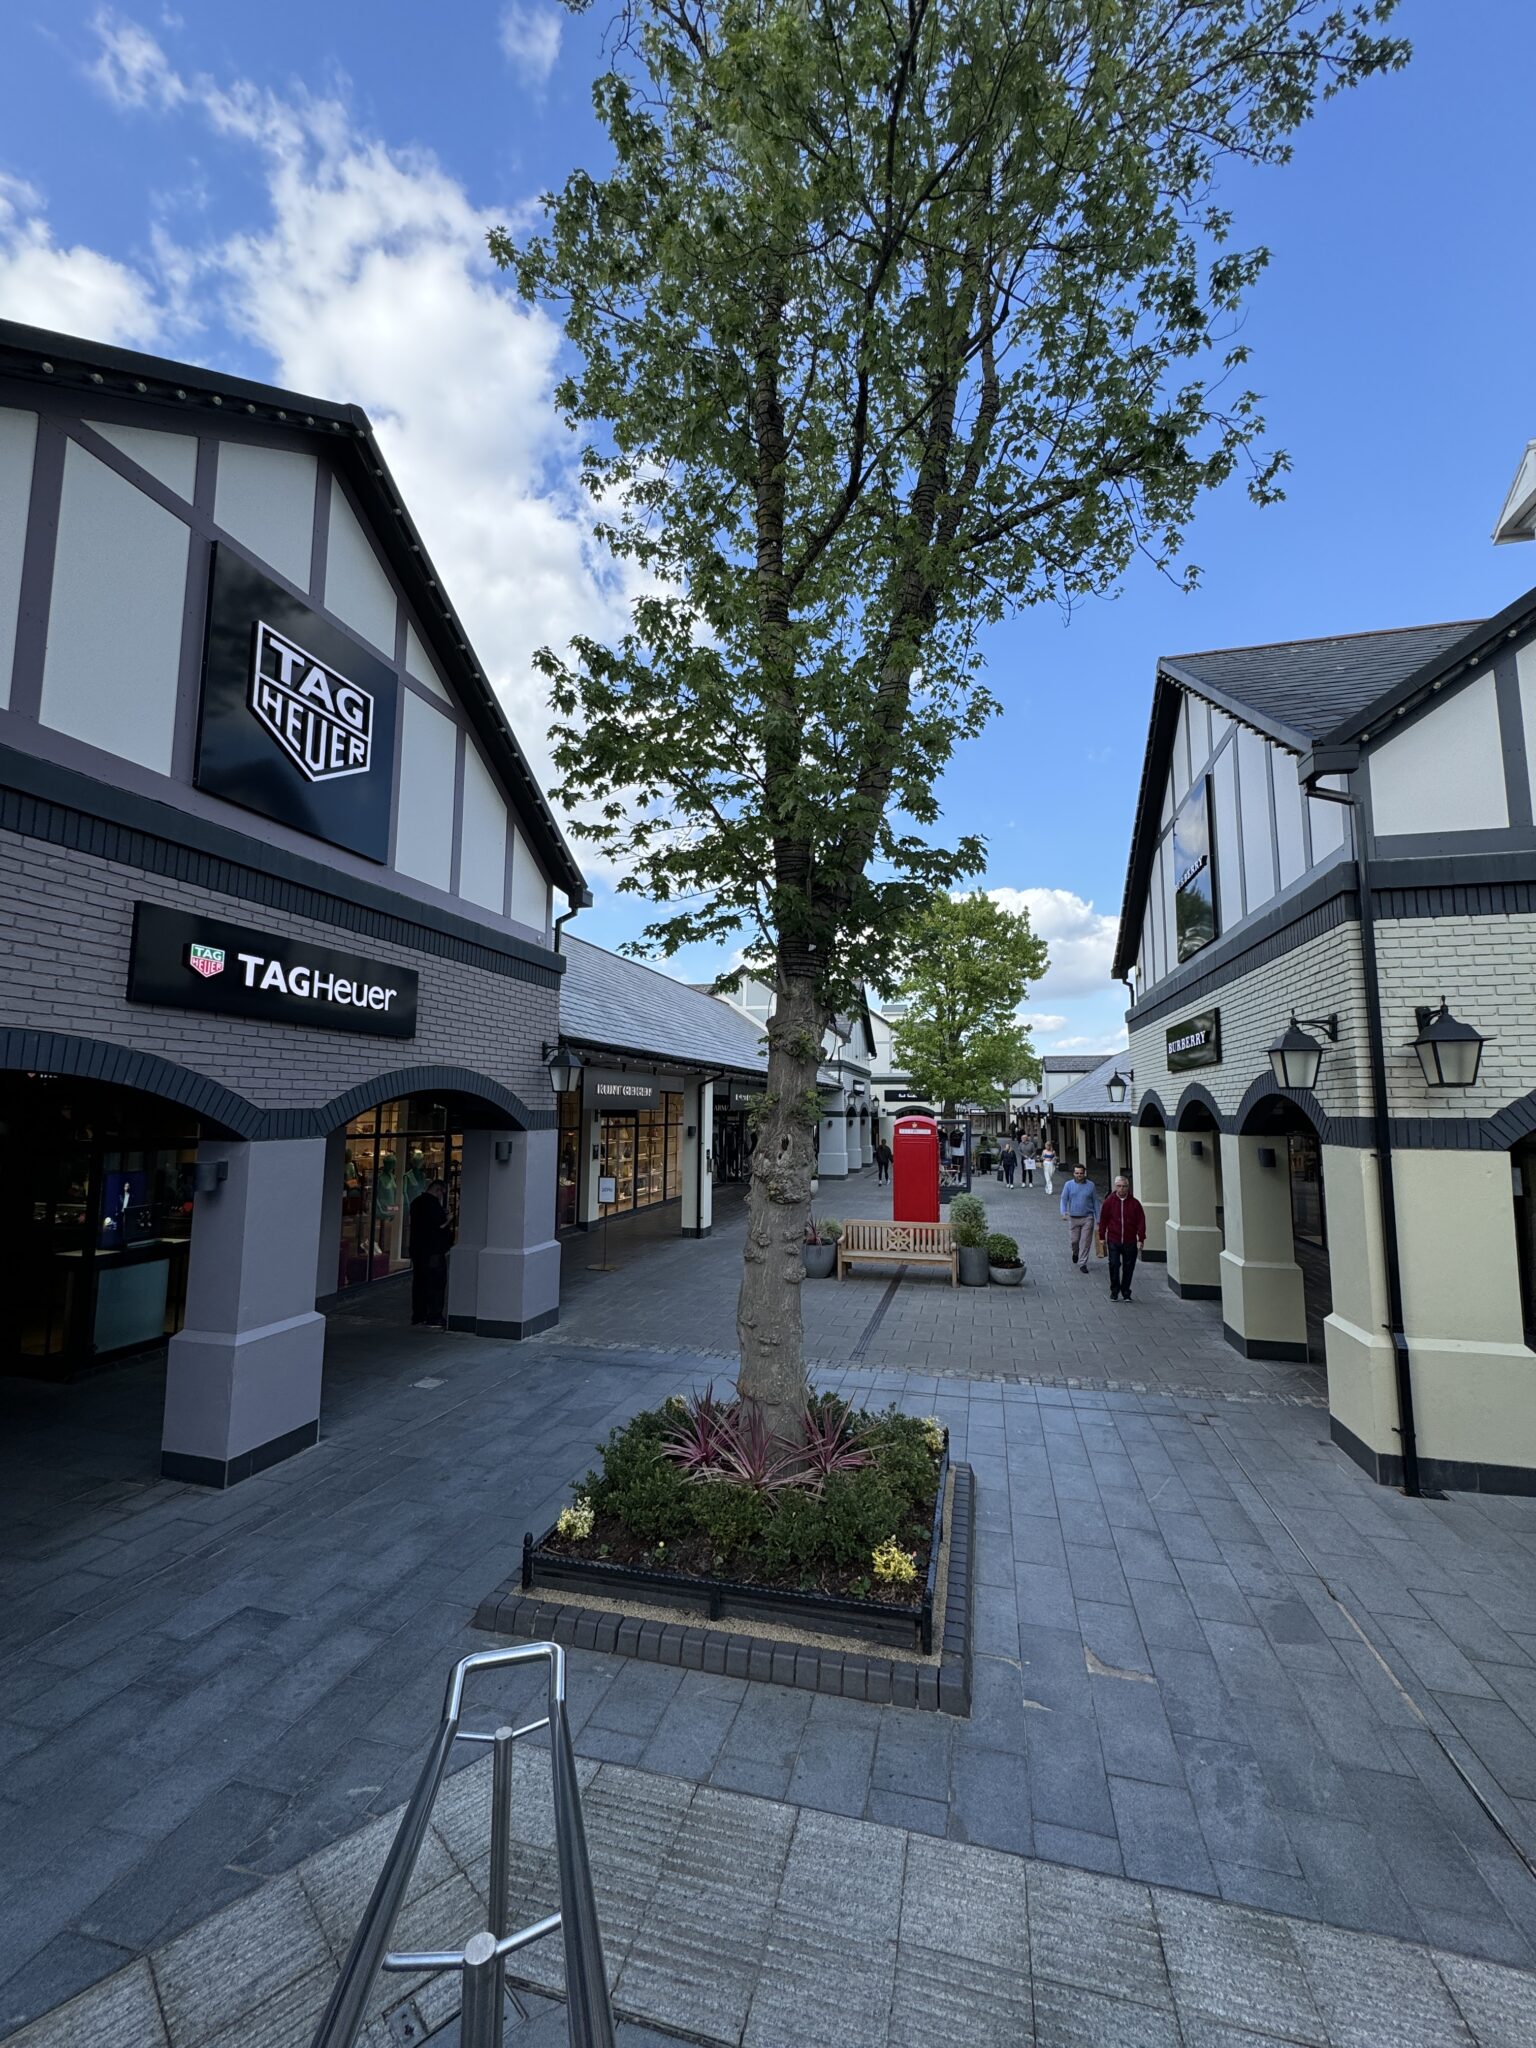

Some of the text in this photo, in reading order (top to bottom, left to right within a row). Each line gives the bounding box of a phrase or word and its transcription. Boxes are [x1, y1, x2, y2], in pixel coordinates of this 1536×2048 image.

[269, 637, 364, 730] TAG
[262, 684, 365, 771] HEUER
[194, 946, 222, 961] TAG
[192, 957, 222, 975] HEUER
[1168, 1030, 1206, 1054] BURBERRY
